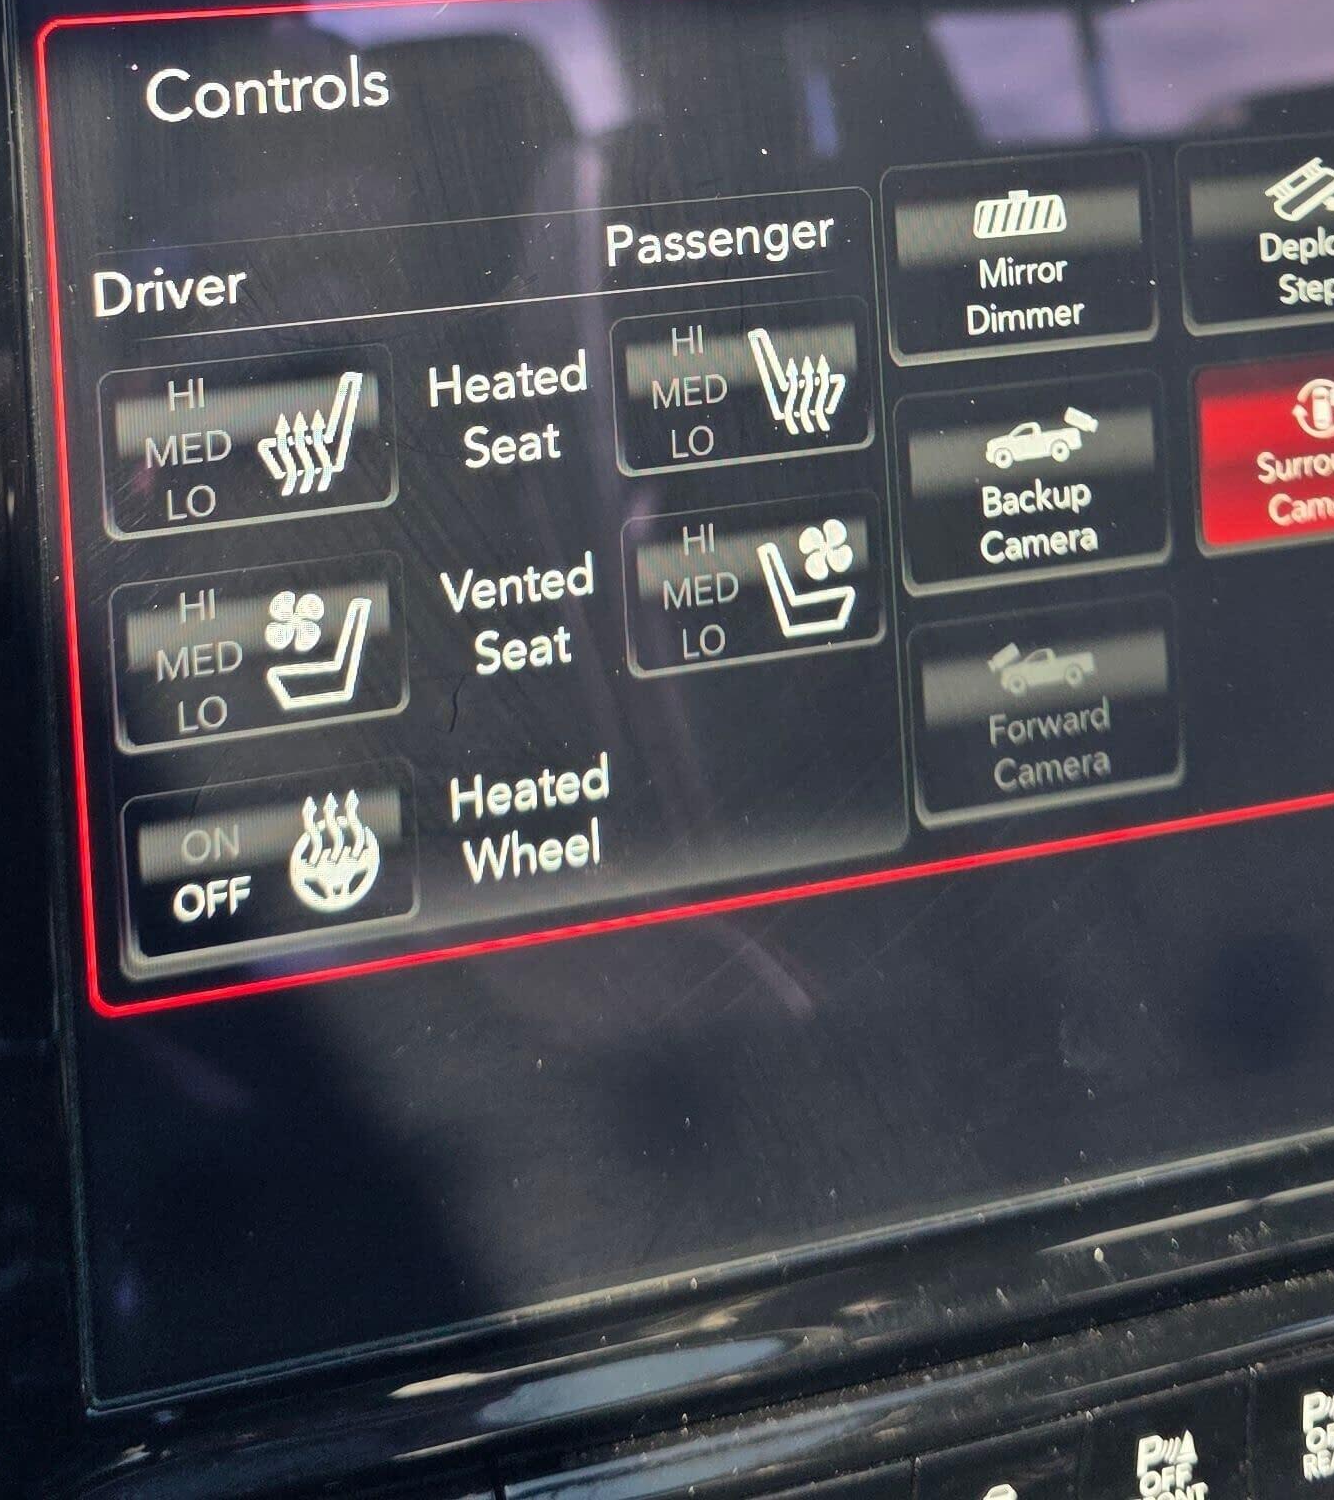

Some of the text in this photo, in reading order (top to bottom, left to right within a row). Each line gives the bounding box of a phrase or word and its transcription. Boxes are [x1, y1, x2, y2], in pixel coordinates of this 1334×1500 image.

[144, 55, 391, 123] Controls
[605, 215, 834, 268] Passenger
[977, 256, 1067, 289] Mirror
[91, 267, 247, 319] Driver
[966, 300, 1085, 336] Dimmer
[672, 324, 705, 357] HI
[167, 377, 207, 413] HI
[427, 349, 588, 408] Heated
[652, 372, 729, 411] MED
[143, 428, 233, 468] MED
[463, 421, 561, 470] Seat
[671, 423, 715, 460] LO
[165, 484, 217, 522] LO
[981, 478, 1093, 519] Backup
[682, 524, 716, 556] HI
[979, 526, 1099, 565] Camera
[440, 550, 595, 614] Vented
[663, 570, 740, 610] MED
[179, 589, 217, 625] HI
[155, 640, 243, 680] MED
[474, 628, 574, 677] Seat
[682, 624, 727, 660] LO
[177, 696, 228, 734] LO
[988, 697, 1110, 748] Forward
[448, 752, 611, 821] Heated
[992, 750, 1112, 793] Camera
[180, 823, 240, 861] ON
[461, 817, 603, 885] Wheel
[171, 874, 252, 924] OFF
[1139, 1462, 1193, 1498] OFF
